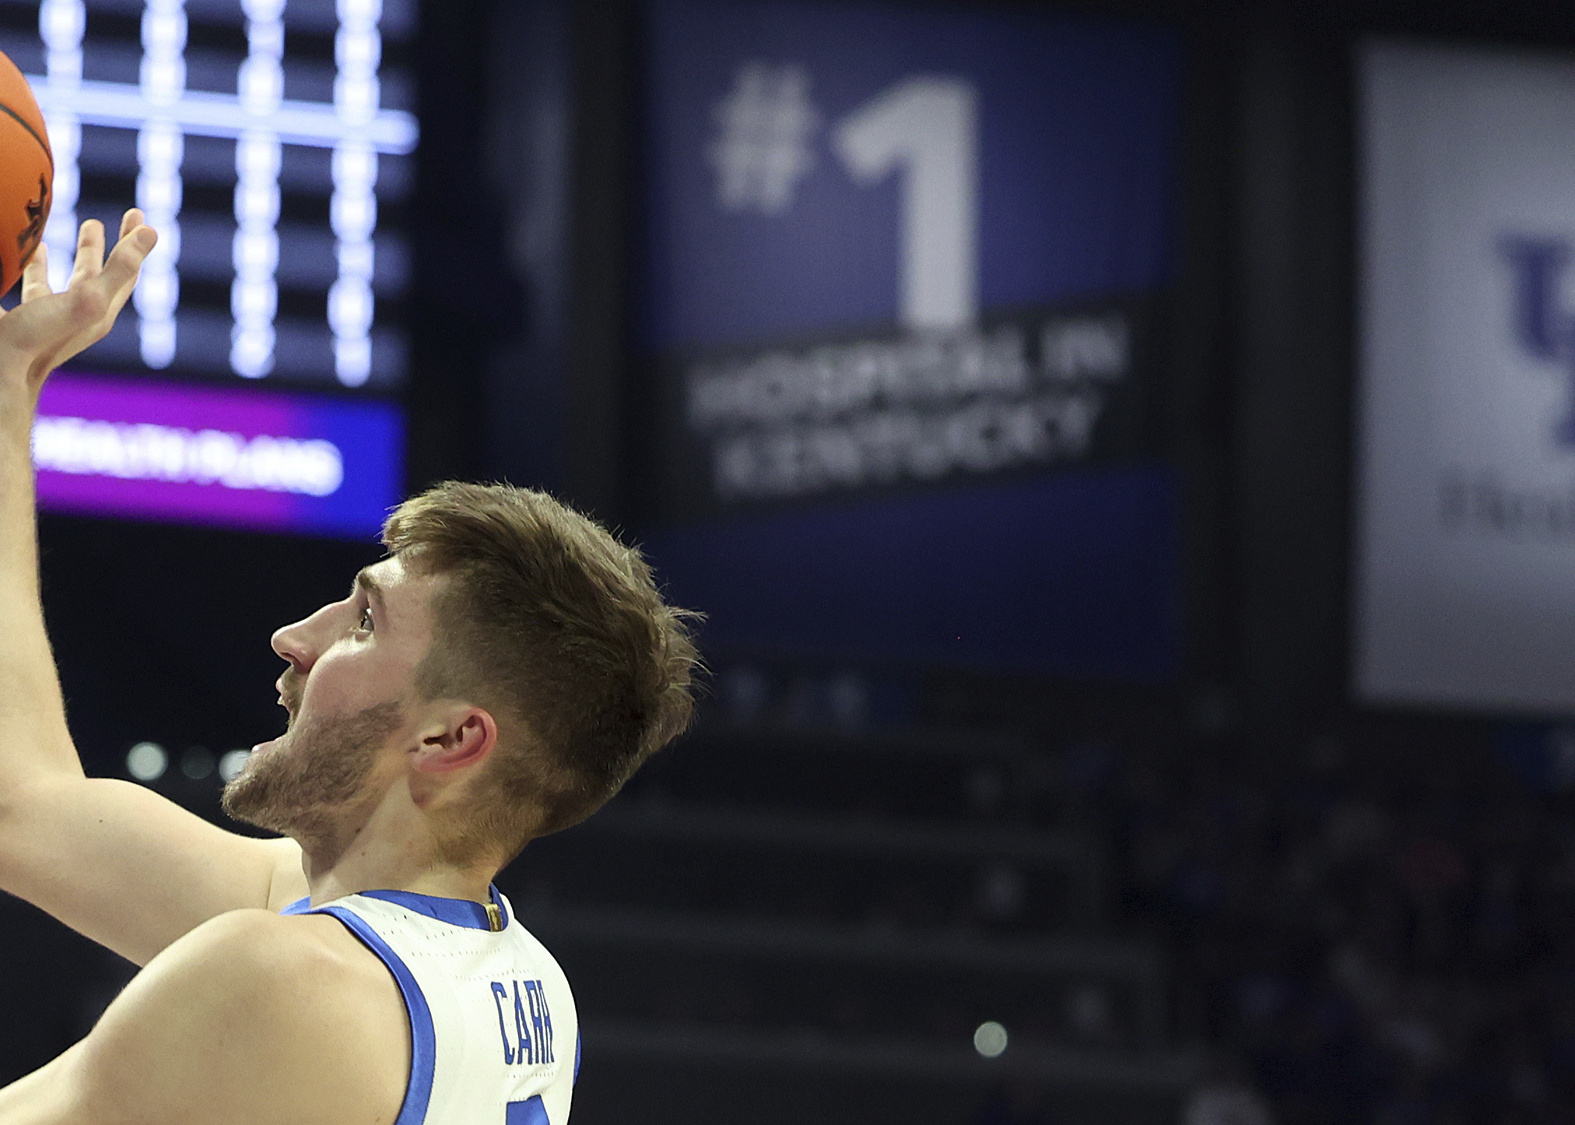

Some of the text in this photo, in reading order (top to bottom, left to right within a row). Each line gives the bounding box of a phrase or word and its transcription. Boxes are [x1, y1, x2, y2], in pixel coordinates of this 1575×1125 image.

[711, 60, 978, 328] #1
[689, 314, 1131, 430] HOSPITAL IN
[716, 391, 1101, 496] KENTUCKY
[490, 979, 555, 1066] CARR
